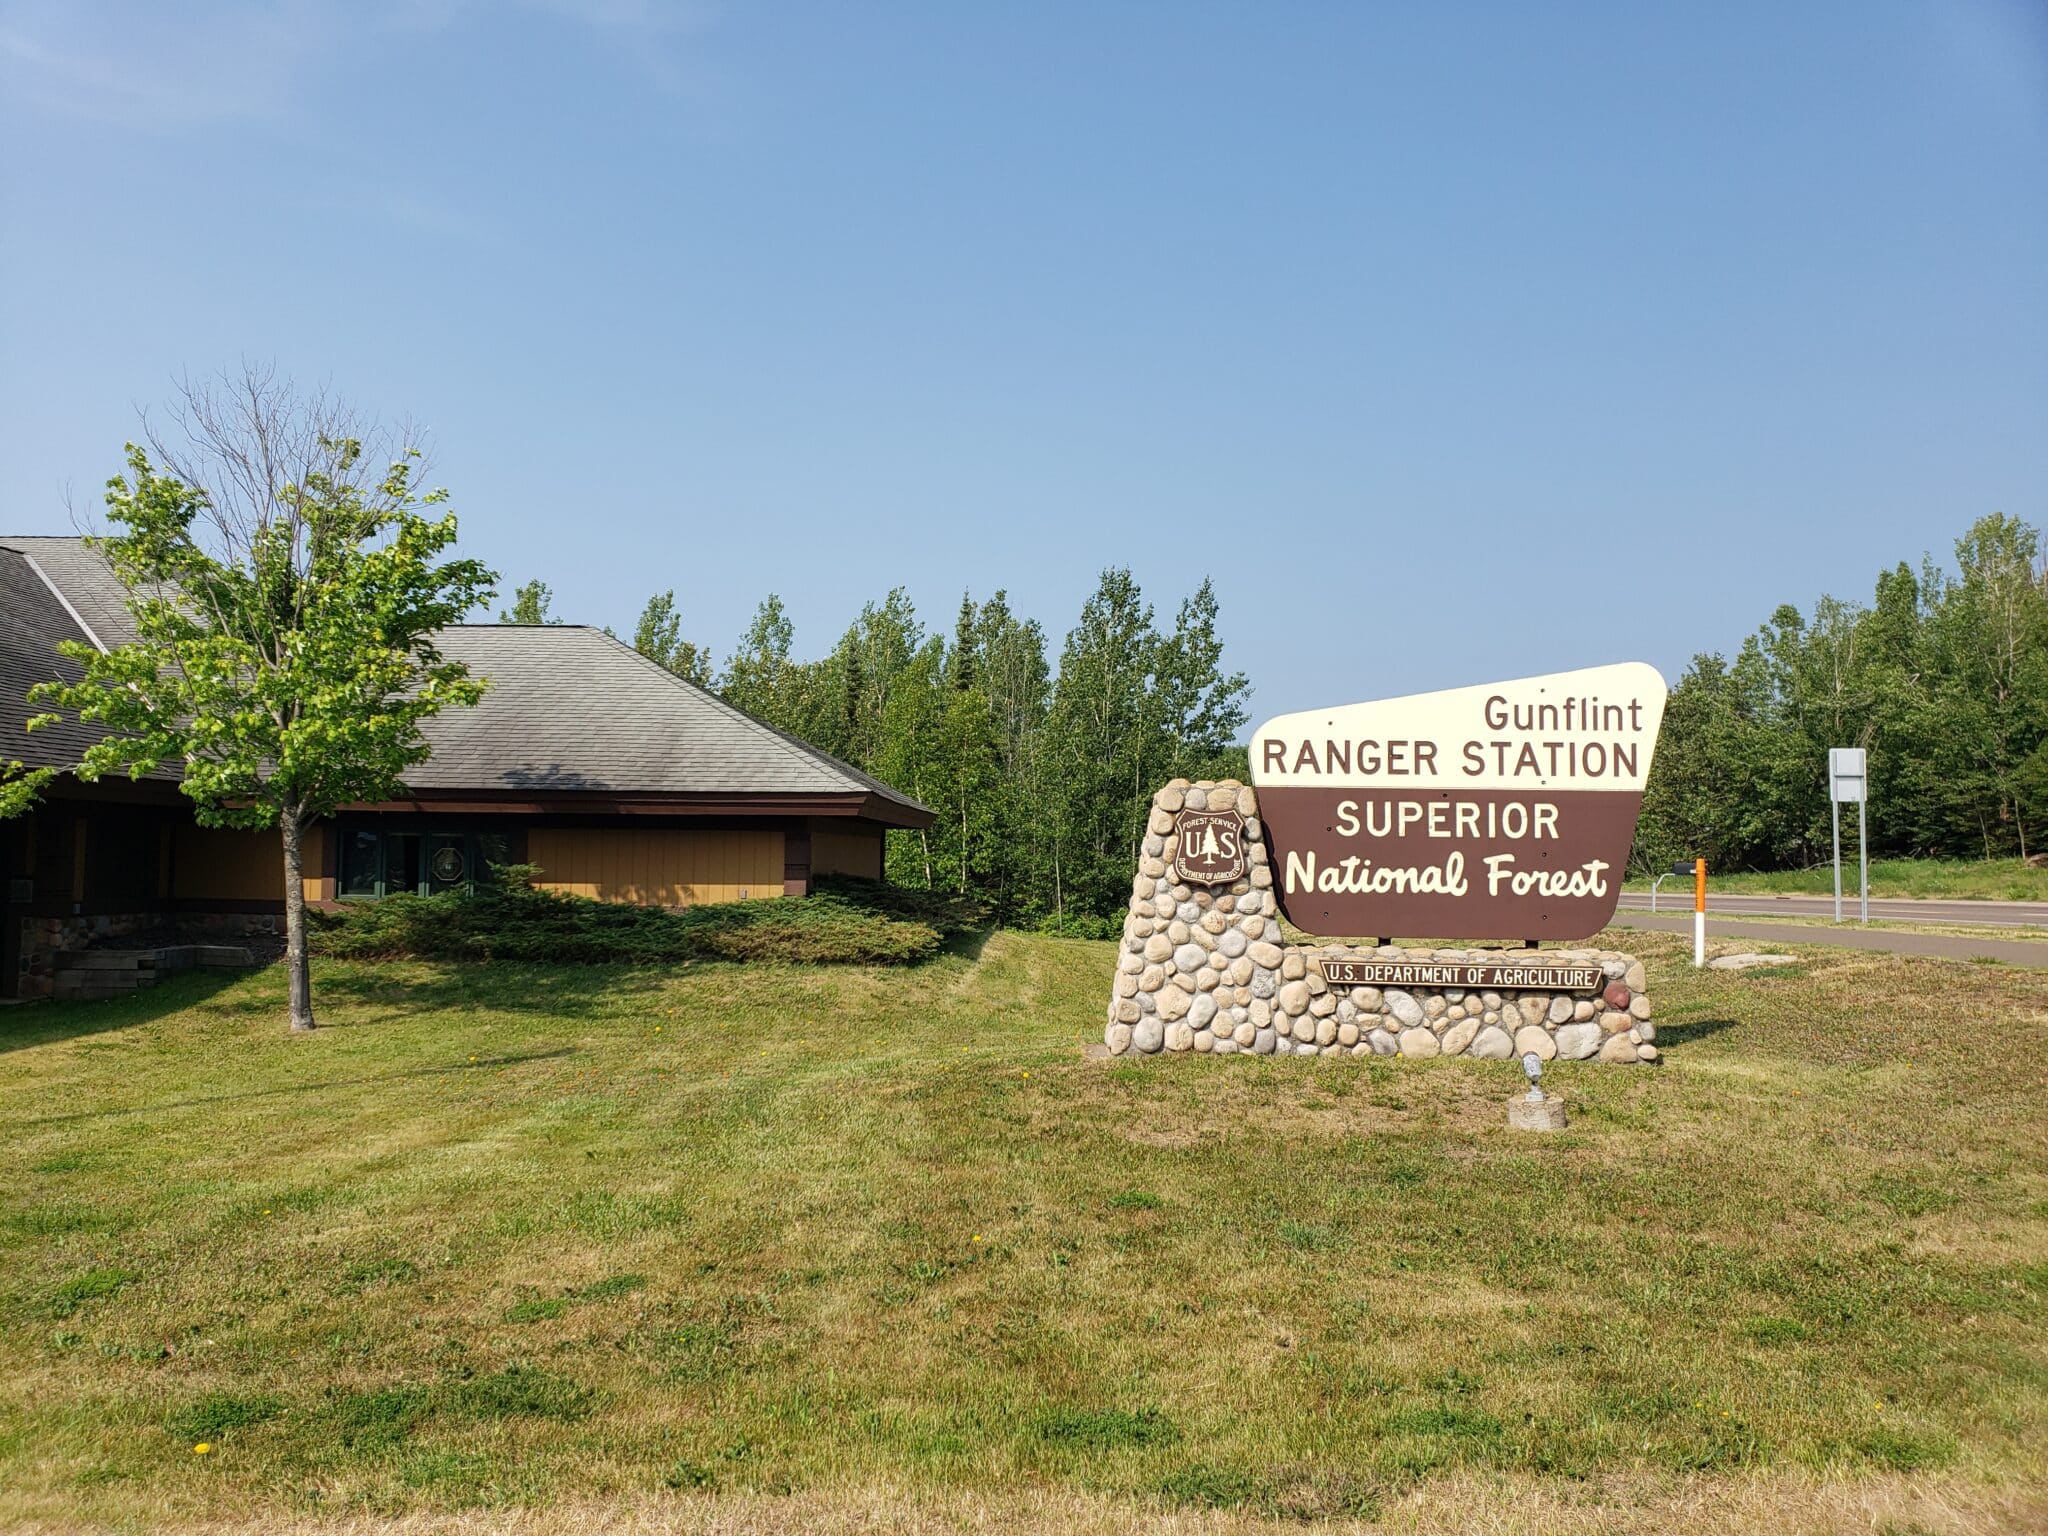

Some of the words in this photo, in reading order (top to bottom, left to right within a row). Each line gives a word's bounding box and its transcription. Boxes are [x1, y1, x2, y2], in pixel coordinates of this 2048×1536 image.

[1484, 695, 1643, 732] Gunflint
[1263, 739, 1438, 775] RANGER
[1462, 741, 1638, 778] STATION
[1183, 817, 1208, 831] FOREST
[1209, 817, 1237, 831] SERVICE
[1336, 801, 1559, 839] SUPERIOR
[1206, 872, 1213, 880] OF
[1286, 851, 1468, 897] National
[1483, 854, 1609, 897] Forest
[1329, 965, 1358, 981] U.S.
[1365, 966, 1459, 983] DEPARTMENT
[1467, 968, 1485, 983] OF
[1493, 969, 1594, 986] AGRICULTURE
